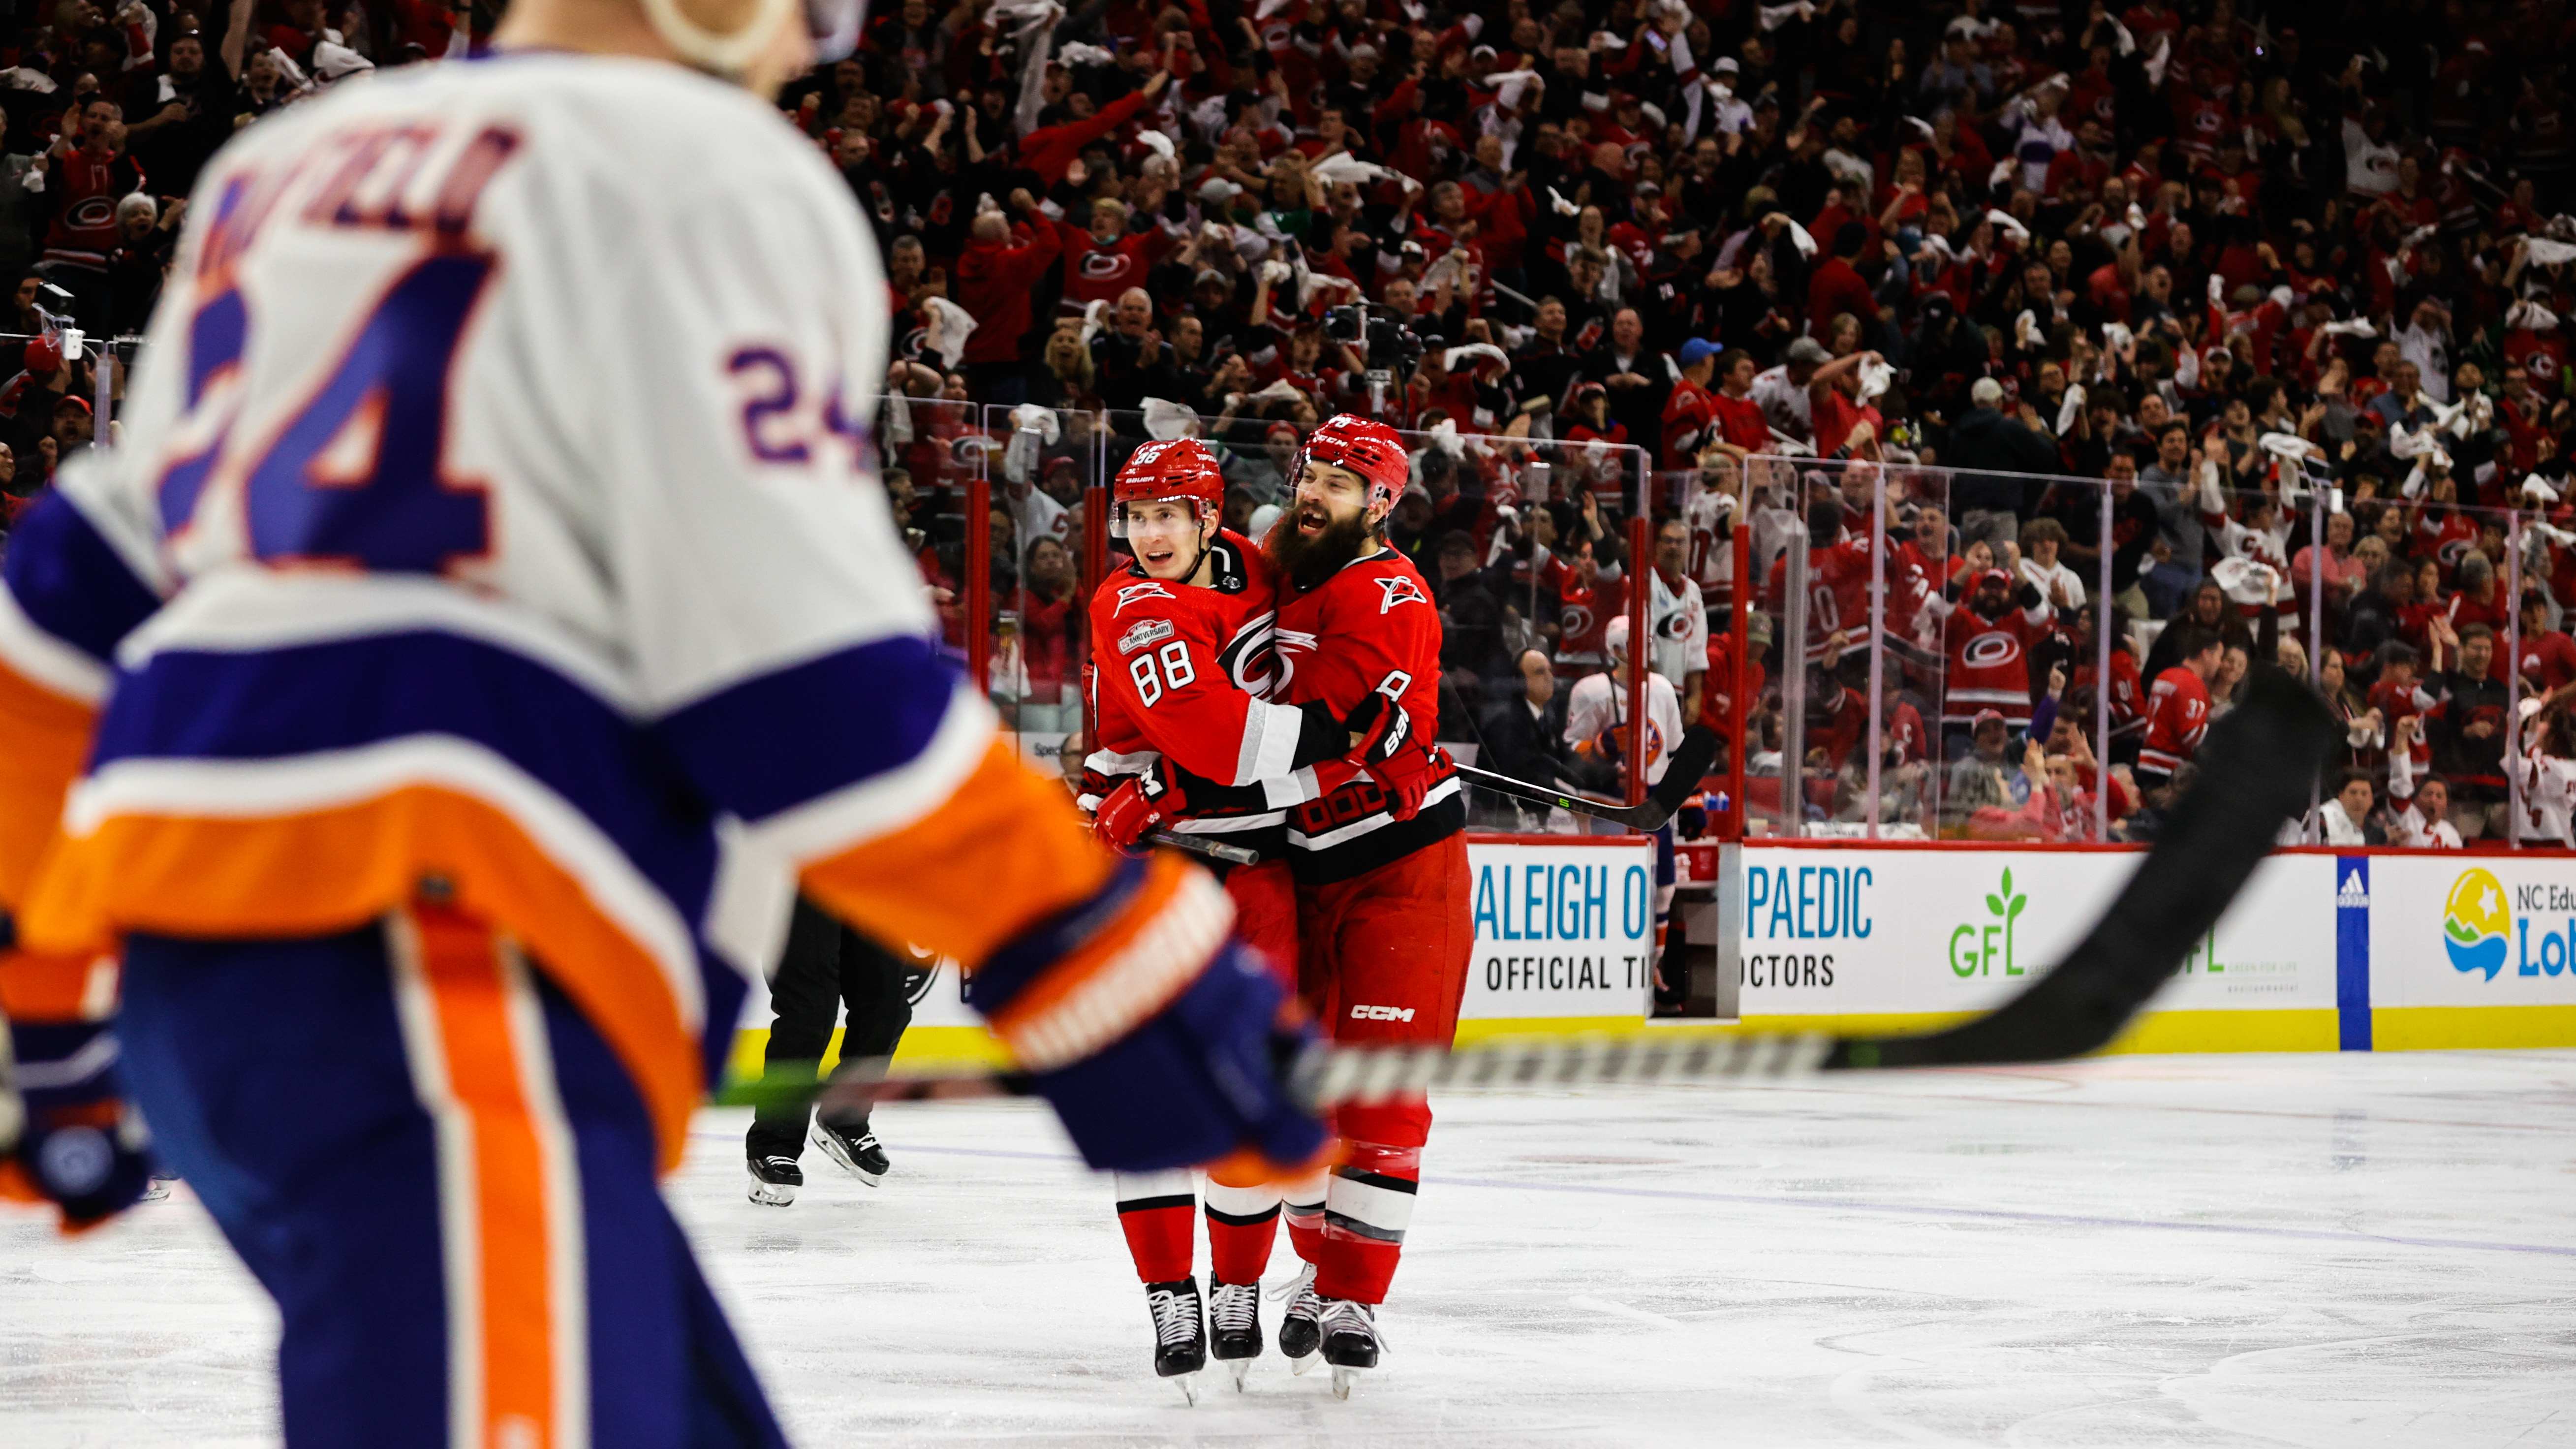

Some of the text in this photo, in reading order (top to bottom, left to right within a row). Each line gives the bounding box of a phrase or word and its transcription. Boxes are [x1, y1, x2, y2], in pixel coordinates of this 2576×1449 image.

[1125, 476, 1155, 484] BAUER
[1129, 625, 1169, 644] ANNIVERSARY
[1129, 640, 1196, 708] 88
[1474, 865, 1872, 940] ALEIGH O PAEDIC
[2518, 884, 2576, 911] NC Edu
[1949, 893, 2027, 978] GFL
[1487, 956, 1612, 990] OFFICIAL
[1350, 1005, 1416, 1022] CCM
